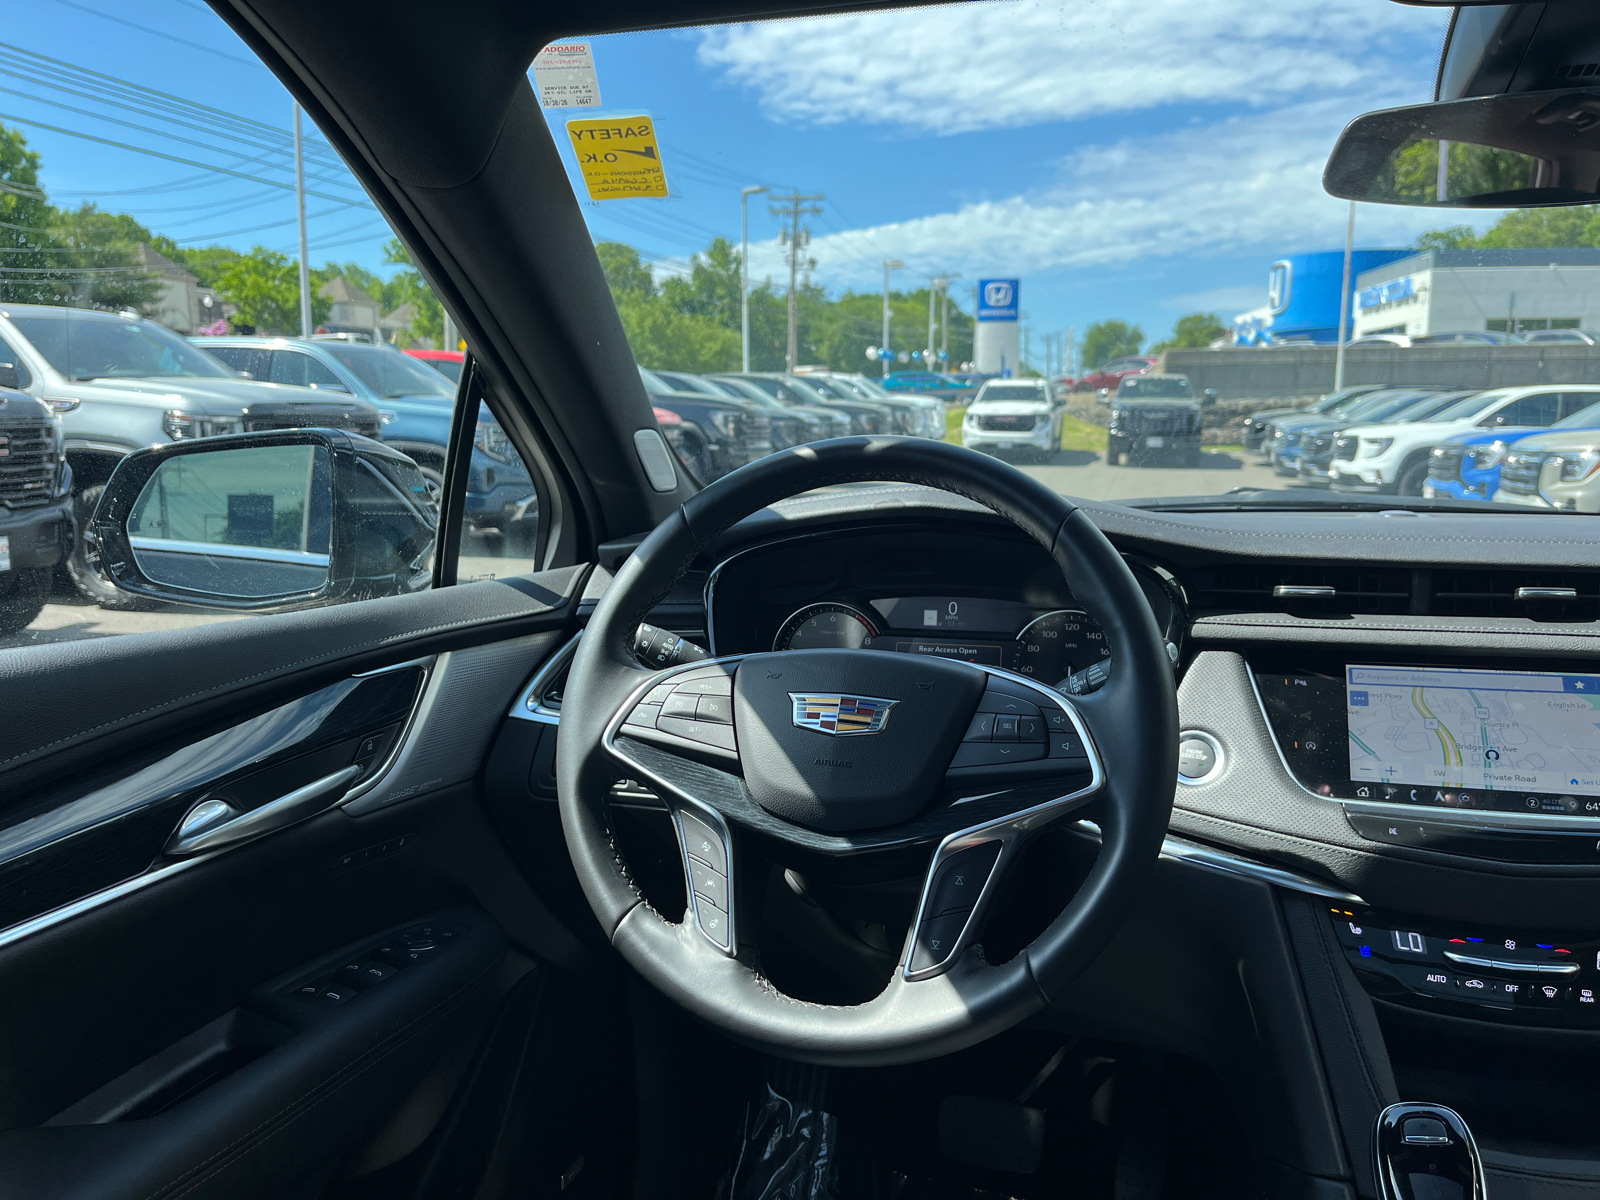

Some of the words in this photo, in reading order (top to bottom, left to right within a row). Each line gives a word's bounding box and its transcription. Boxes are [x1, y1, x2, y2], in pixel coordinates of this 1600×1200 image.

[948, 601, 958, 615] 0
[811, 619, 817, 627] 5
[1064, 623, 1080, 631] 120
[1042, 630, 1058, 638] 100
[1086, 632, 1102, 640] 140
[864, 637, 871, 645] 8
[935, 646, 958, 654] Access
[958, 647, 977, 655] Open
[1027, 644, 1040, 652] 80
[1099, 647, 1110, 656] 16
[1020, 665, 1033, 673] 60
[1367, 673, 1399, 682] Keyword
[1384, 692, 1403, 700] Pkwy
[1547, 701, 1576, 709] English
[1480, 721, 1510, 729] Country
[1455, 742, 1501, 752] Bridgept
[1502, 745, 1518, 753] Ave
[814, 759, 852, 768] AIRBAG
[1433, 769, 1446, 777] SW
[1483, 773, 1513, 781] Private
[1514, 775, 1537, 783] Road
[1426, 973, 1447, 984] AUTO
[1505, 984, 1519, 993] OFF
